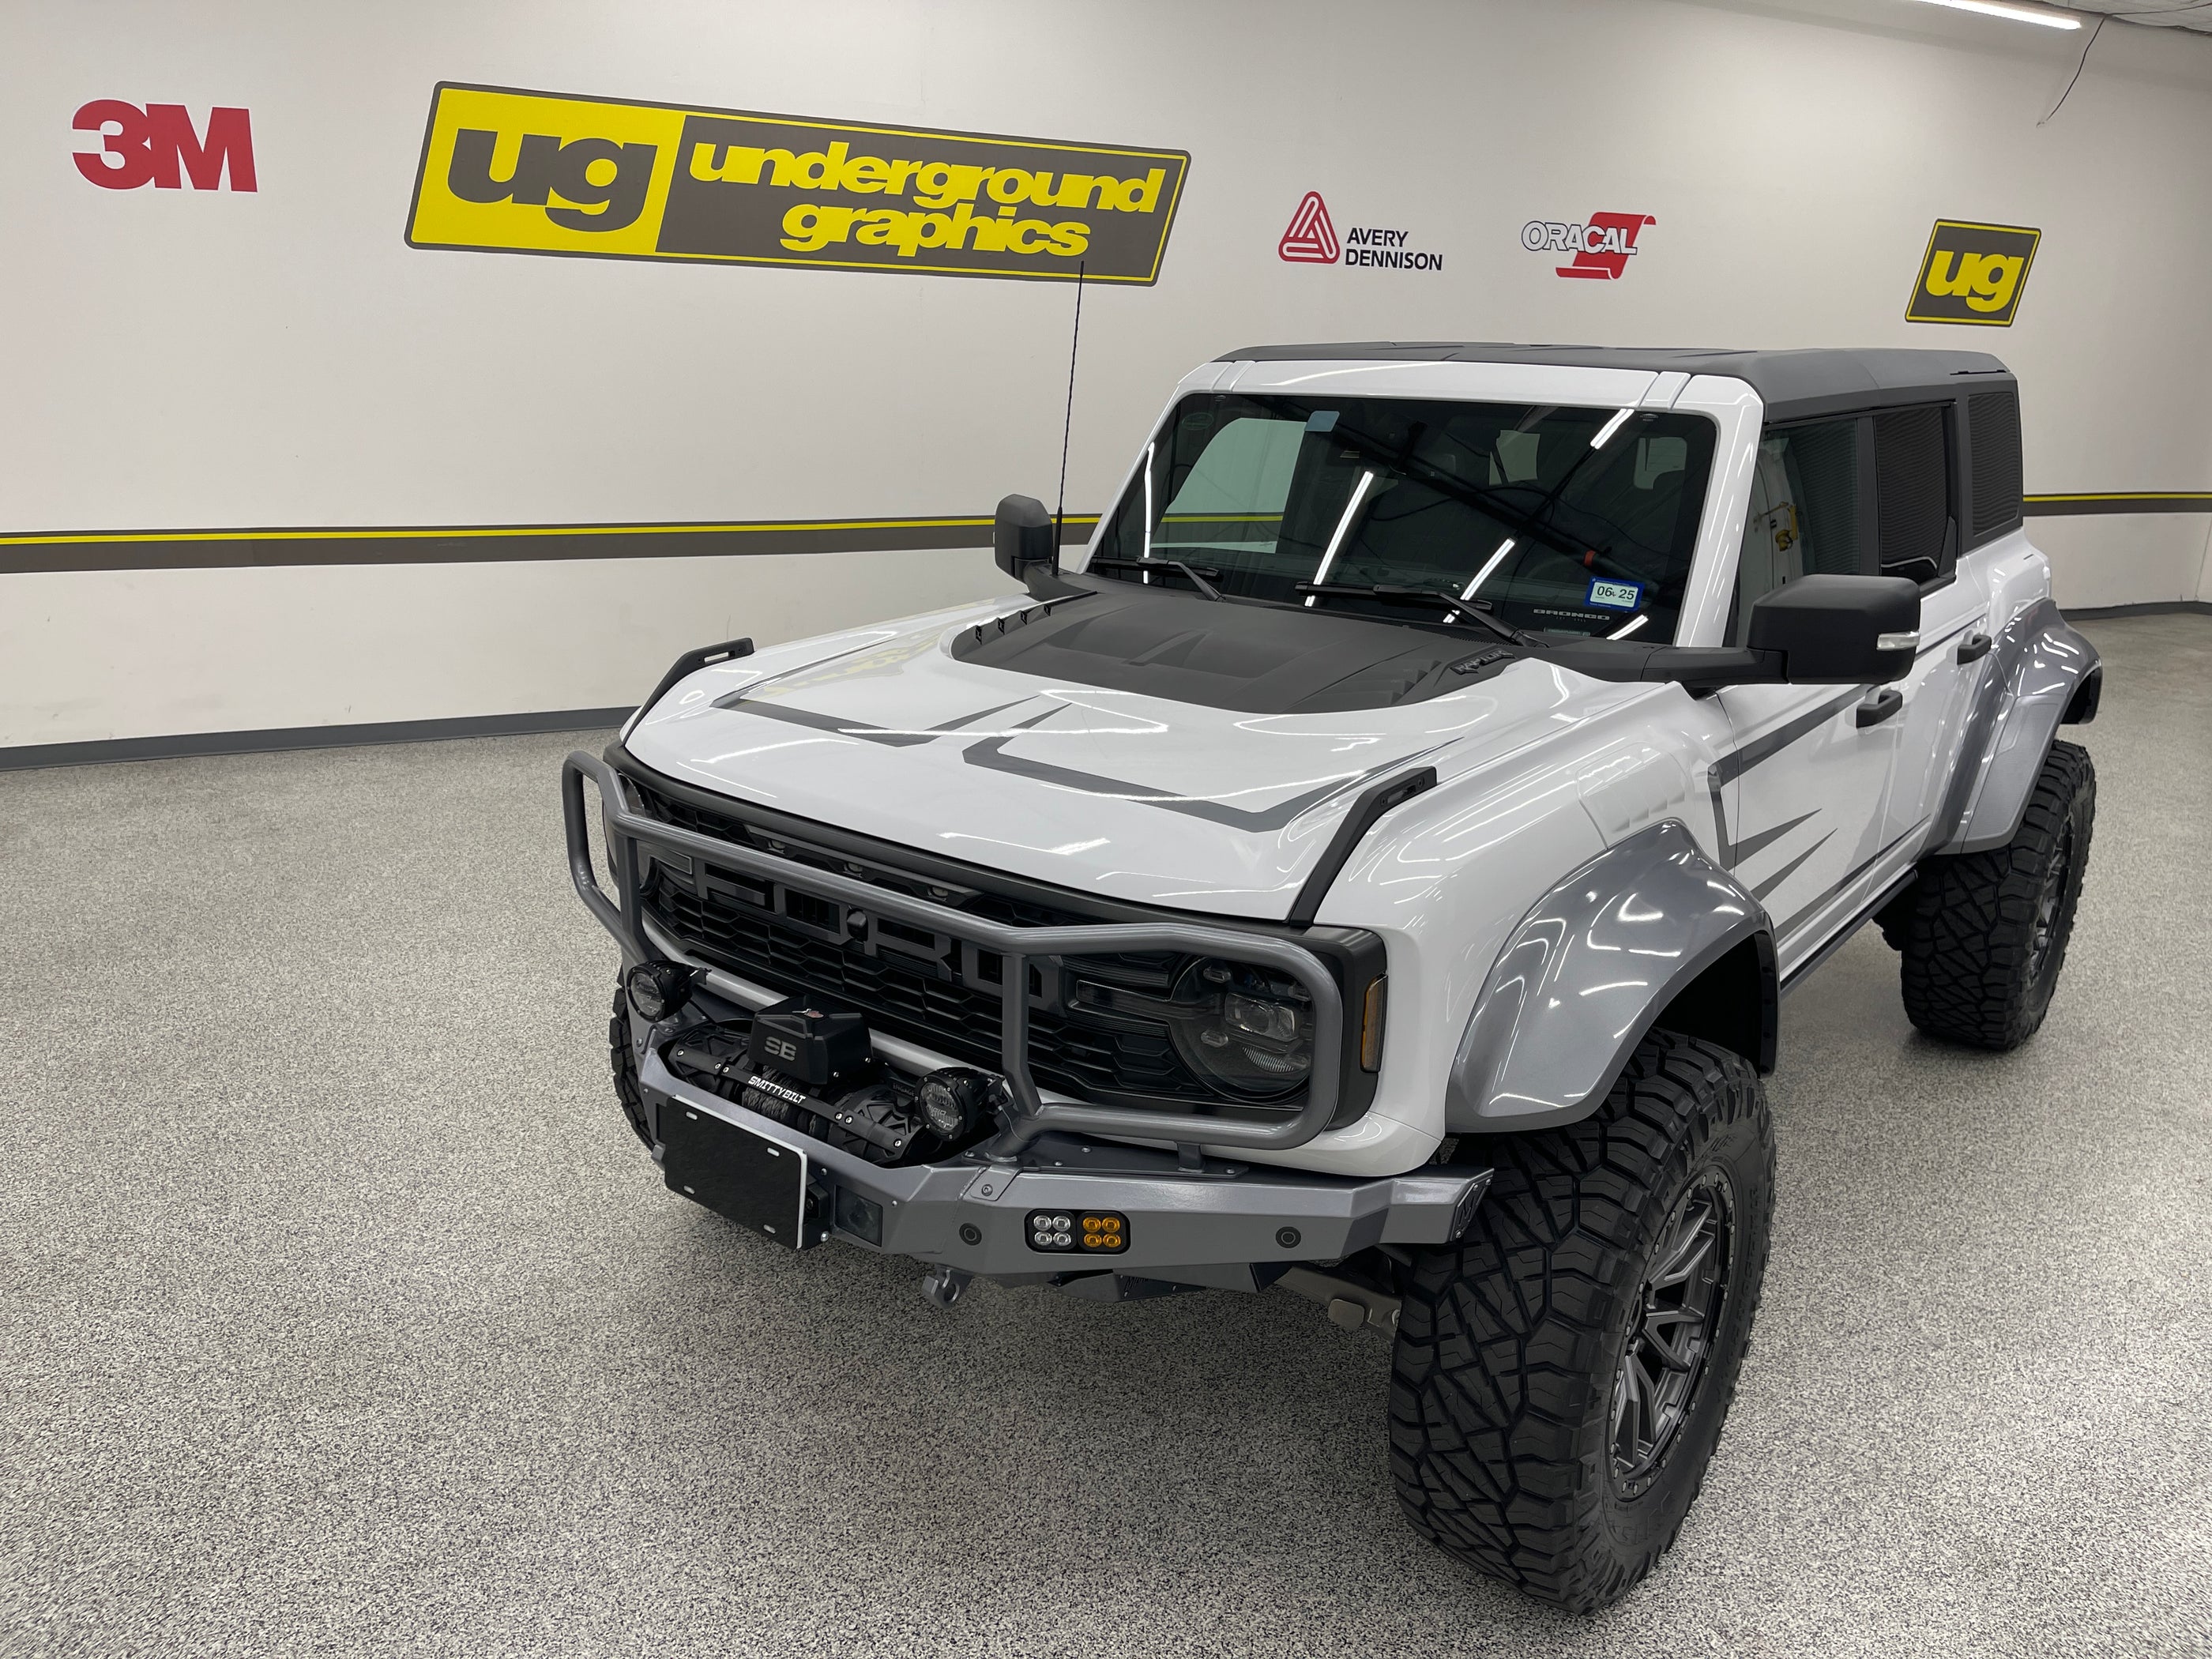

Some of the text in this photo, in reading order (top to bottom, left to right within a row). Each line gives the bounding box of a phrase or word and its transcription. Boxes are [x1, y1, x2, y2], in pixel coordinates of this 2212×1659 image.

[73, 100, 258, 193] 3M
[447, 128, 658, 232] ug
[689, 141, 1166, 213] underground
[780, 203, 1091, 257] graphics
[1346, 228, 1409, 248] AVERY
[1521, 220, 1638, 256] ORACAL
[1345, 249, 1443, 271] DENNISON
[1925, 250, 2025, 313] ug
[1597, 585, 1635, 600] 06 25
[1533, 608, 1611, 621] BRONCO
[1451, 649, 1514, 674] RAPTOR
[748, 1075, 807, 1104] SMITTYBILT
